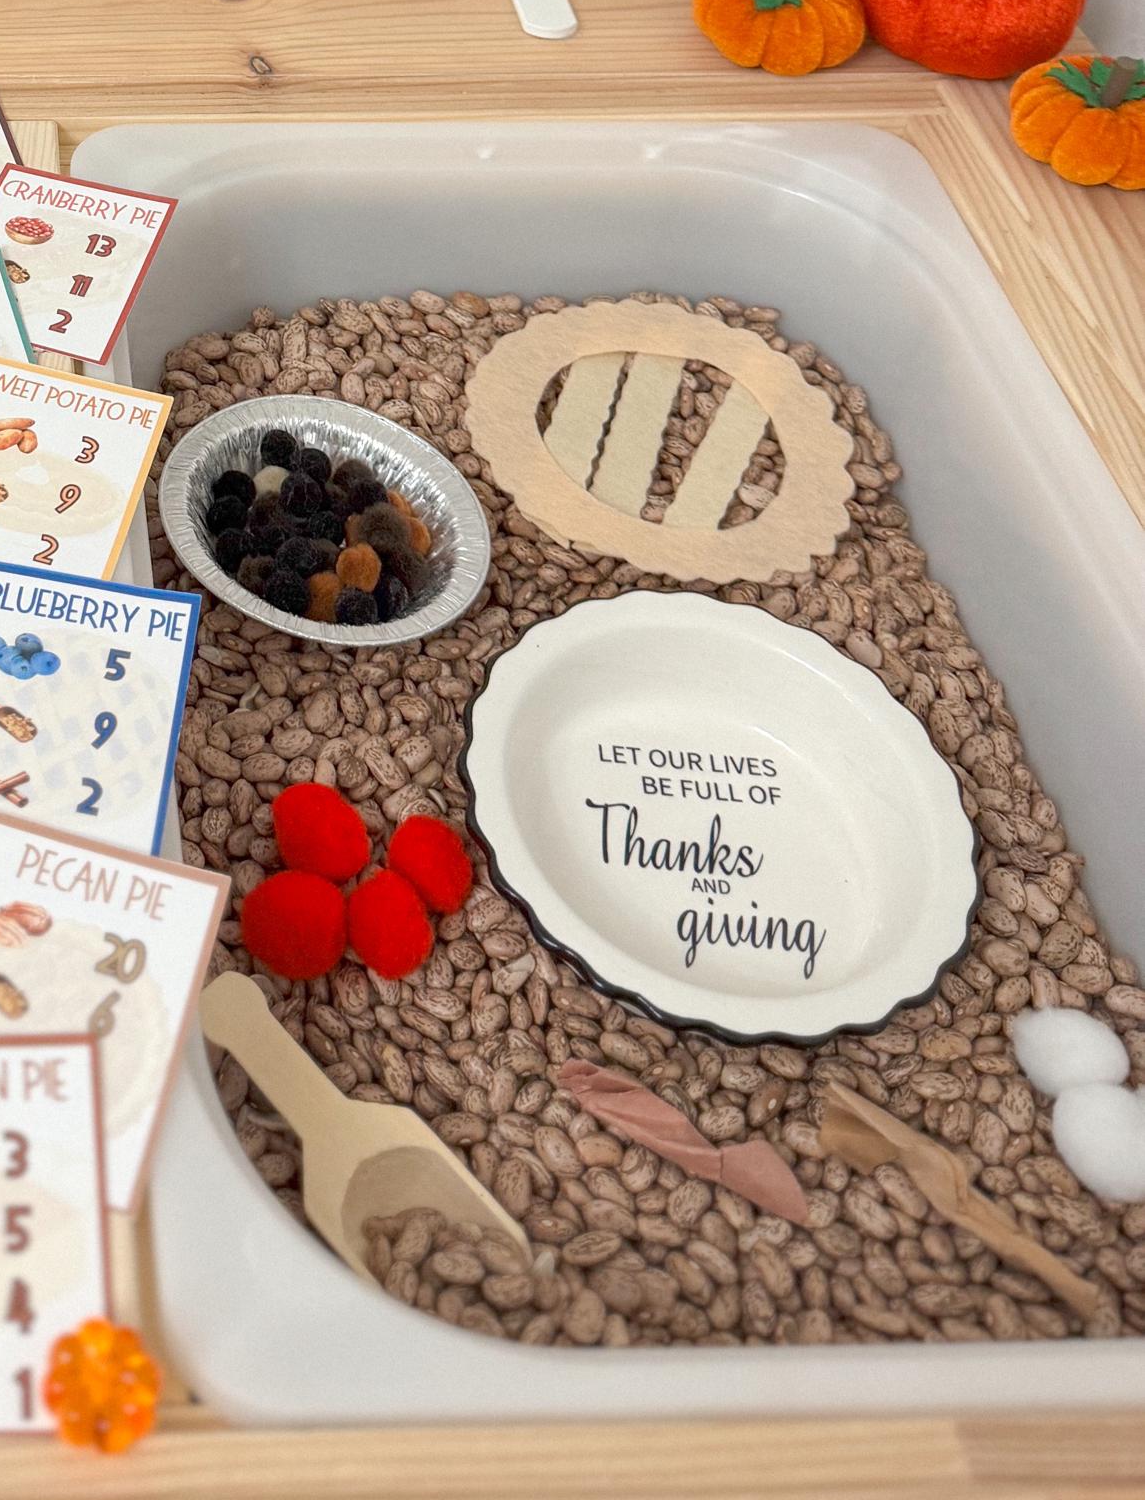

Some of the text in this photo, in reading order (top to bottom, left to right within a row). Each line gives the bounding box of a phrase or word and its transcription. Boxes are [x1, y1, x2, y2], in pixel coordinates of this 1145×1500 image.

[3, 179, 162, 229] CRANBERRY PIE
[84, 233, 117, 257] 13
[69, 274, 94, 297] 11
[48, 309, 72, 333] 2
[44, 390, 125, 420] POTATO
[129, 406, 157, 429] PIE
[74, 436, 100, 464] 3
[55, 483, 82, 514] 9
[33, 534, 59, 565] 2
[148, 610, 187, 641] PIE
[104, 648, 132, 681] 5
[91, 711, 117, 749] 9
[598, 744, 777, 778] LET OUR LIVES
[76, 778, 103, 816] 2
[642, 776, 782, 805] BE FULL OF
[585, 798, 764, 878] Thanks
[16, 843, 173, 921] PECAN PIE
[692, 878, 731, 895] AND
[677, 898, 826, 980] giving
[94, 932, 147, 985] 20
[89, 991, 121, 1038] 6
[23, 1059, 68, 1101] PIE
[3, 1130, 29, 1179] 3
[4, 1206, 31, 1253] 5
[4, 1277, 34, 1334] 4
[15, 1367, 31, 1421] 1
